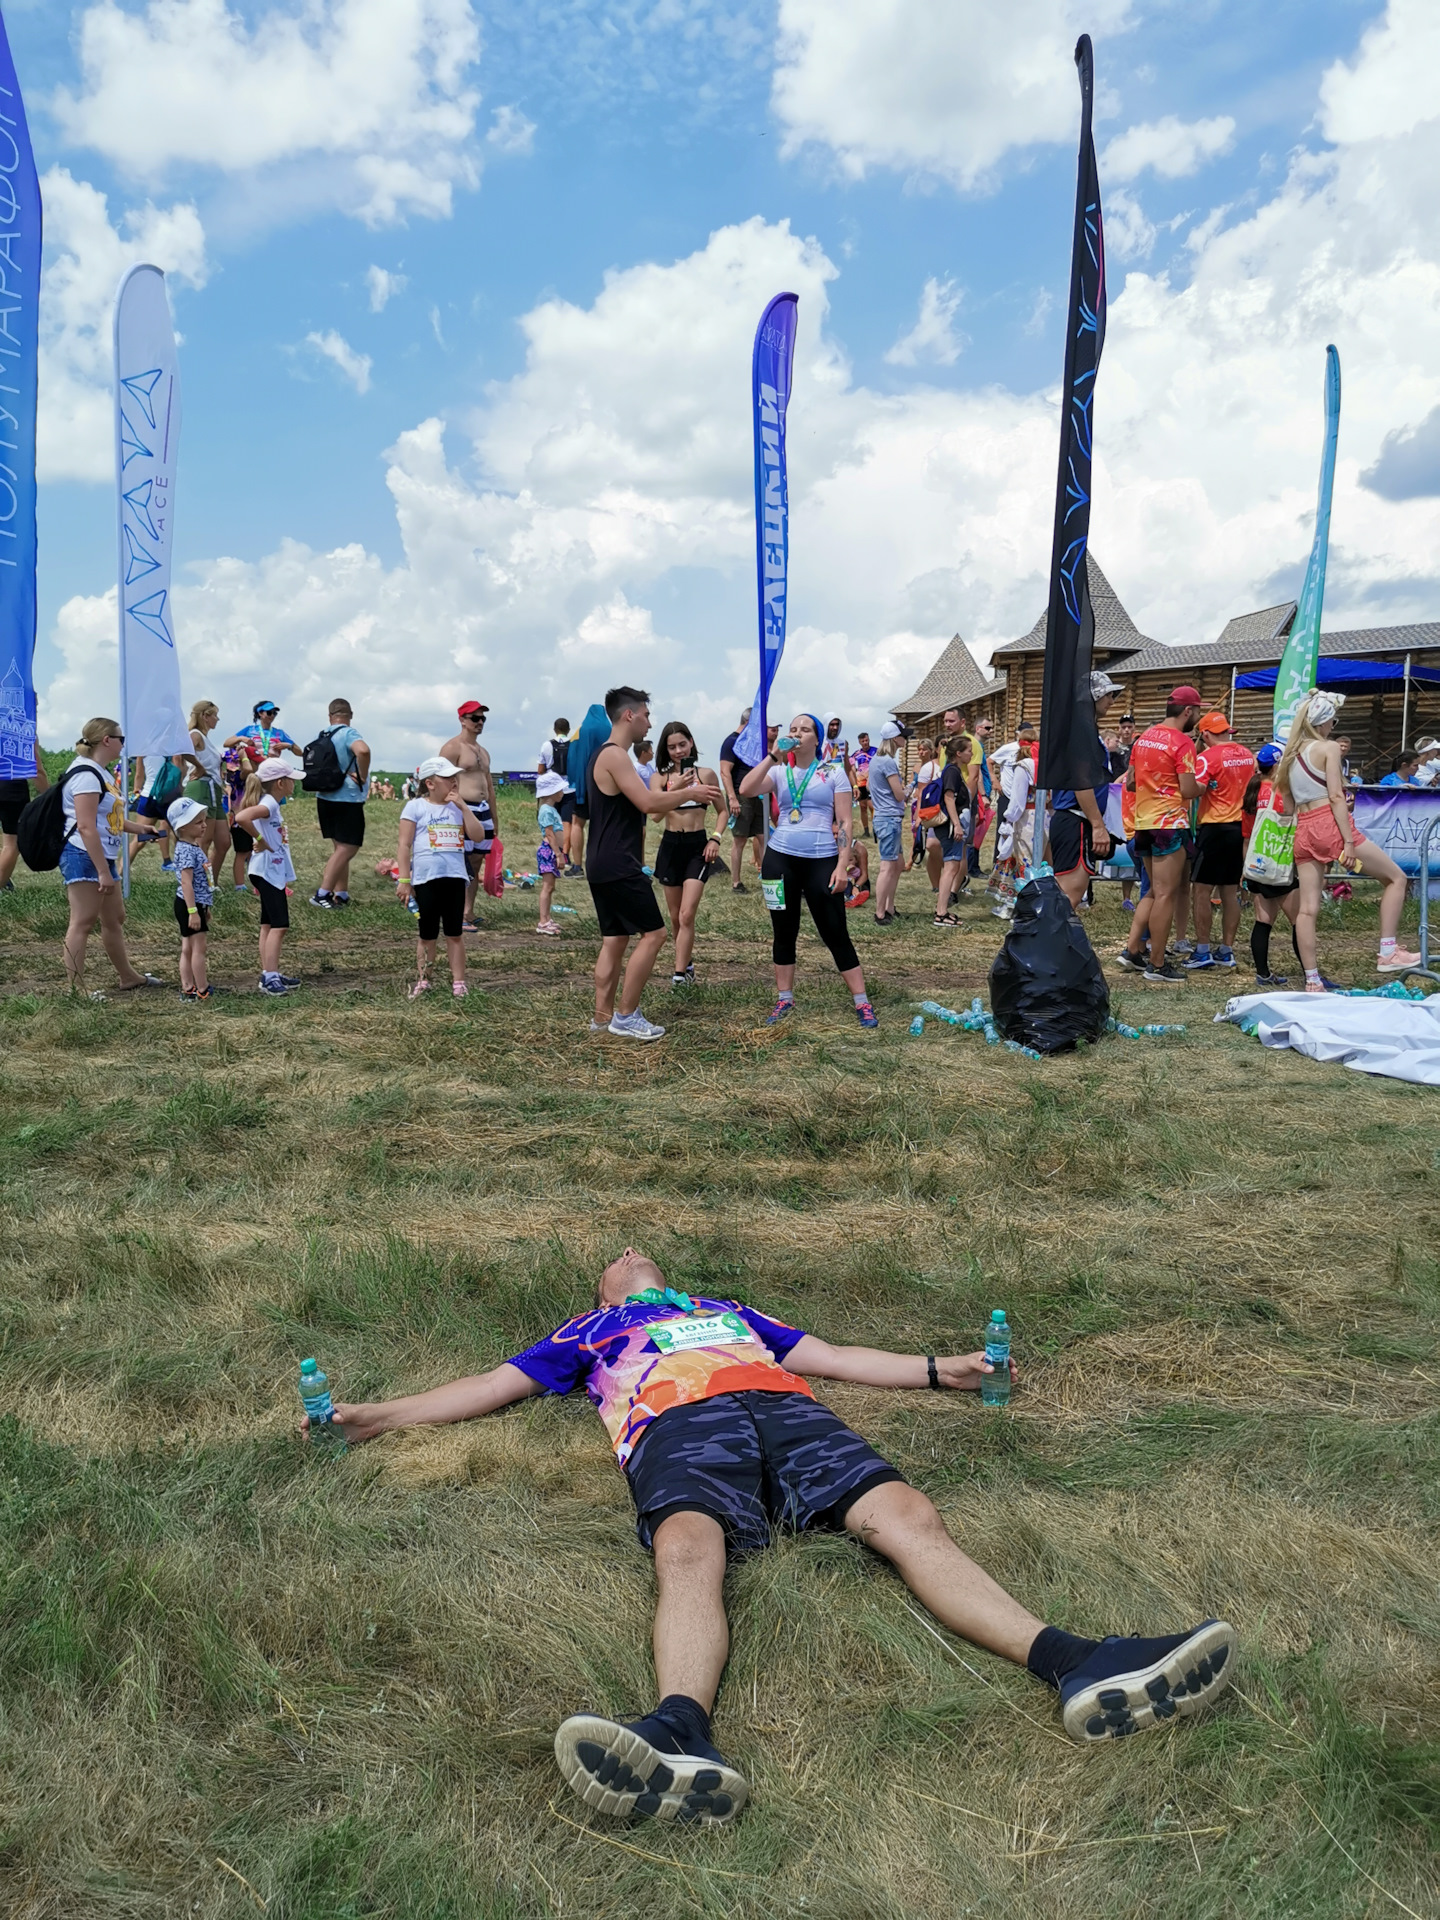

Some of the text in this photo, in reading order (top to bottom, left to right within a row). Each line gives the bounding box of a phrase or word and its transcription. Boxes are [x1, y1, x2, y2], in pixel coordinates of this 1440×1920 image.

[155, 475, 169, 545] ACE
[759, 382, 787, 650] ЕЛЕЦКИЙ
[1134, 739, 1169, 751] ОЛОНТЕР
[676, 1321, 718, 1333] 1016
